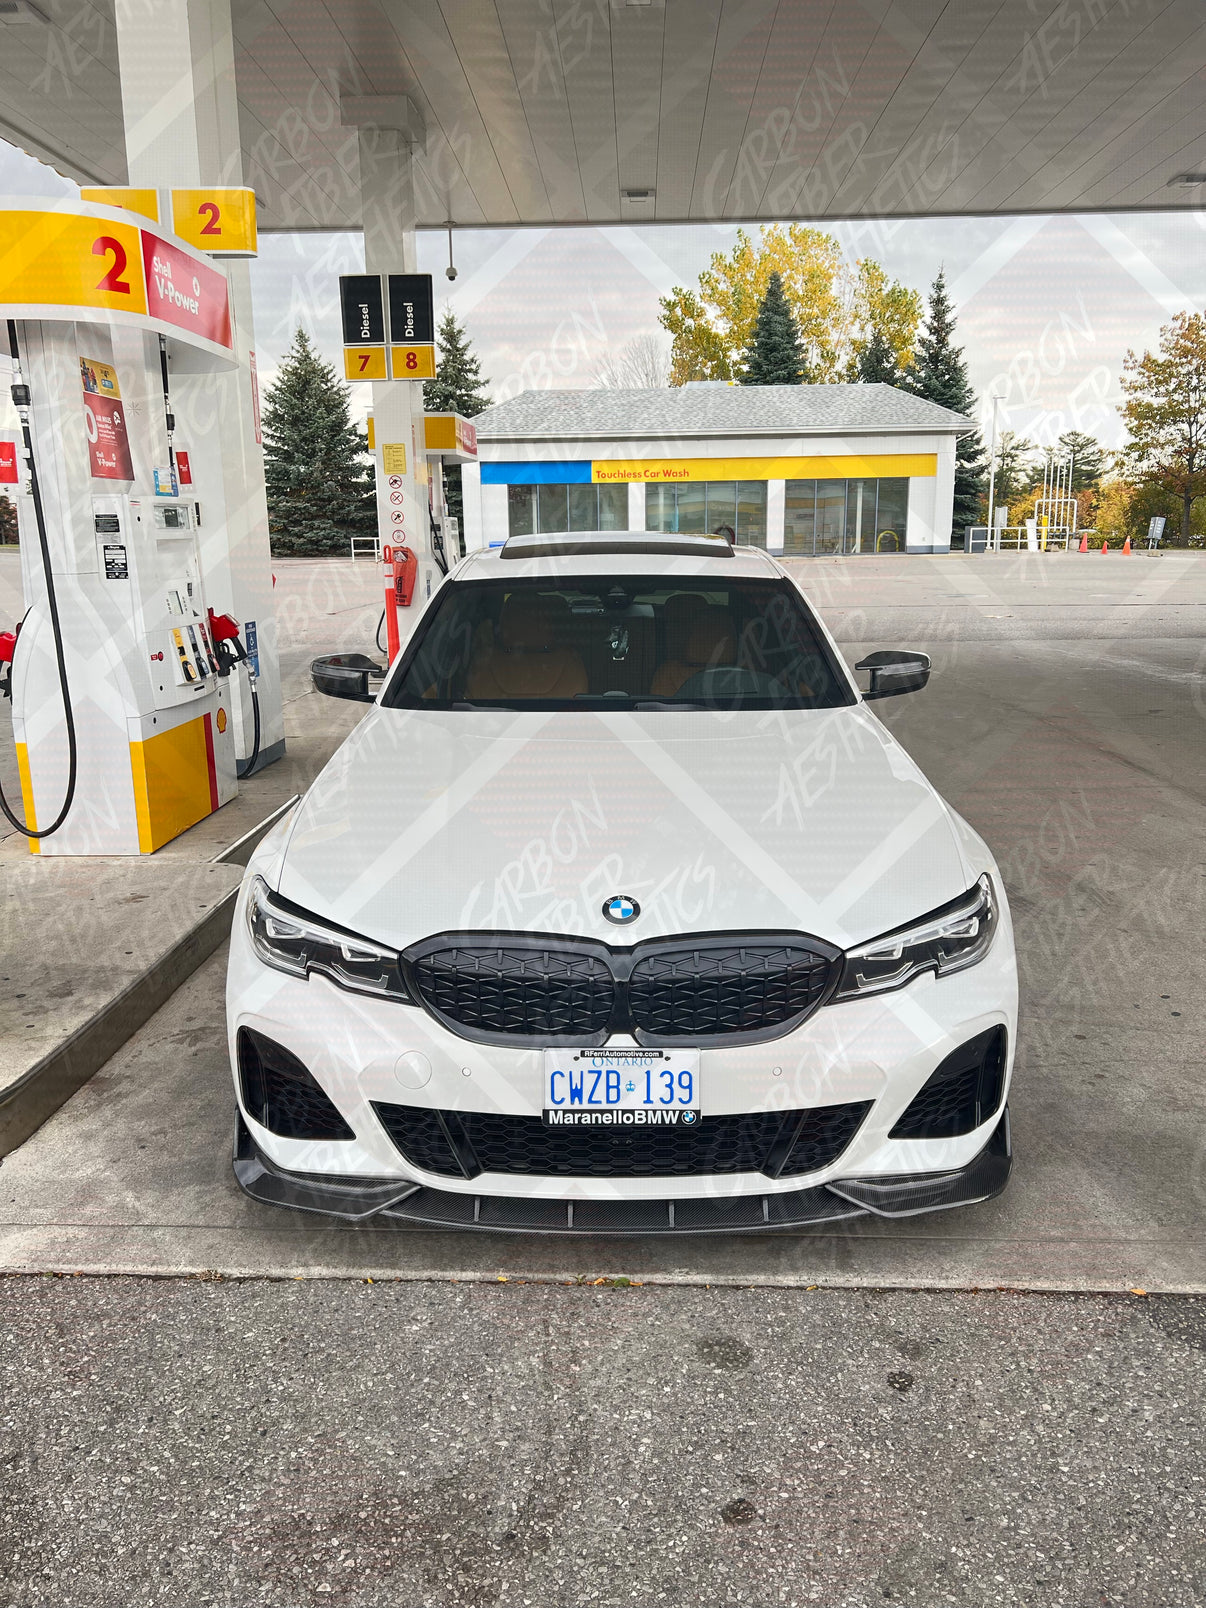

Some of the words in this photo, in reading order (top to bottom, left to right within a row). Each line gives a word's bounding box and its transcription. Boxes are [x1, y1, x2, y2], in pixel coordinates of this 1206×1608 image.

[198, 202, 221, 235] 2
[92, 236, 130, 294] 2
[153, 256, 172, 279] Shell
[154, 275, 199, 315] V-Power
[358, 304, 371, 338] Diesel
[403, 302, 415, 337] Diesel
[358, 354, 371, 372] 7
[405, 352, 418, 370] 8
[596, 469, 642, 480] Touchless
[643, 469, 661, 479] Car
[662, 469, 690, 478] Wash
[584, 1050, 660, 1058] RFerriAutomotive.com
[592, 1056, 653, 1068] ONTARIO
[550, 1069, 621, 1105] CWZB
[643, 1070, 693, 1105] 139
[548, 1110, 680, 1125] MaranelloBMW
